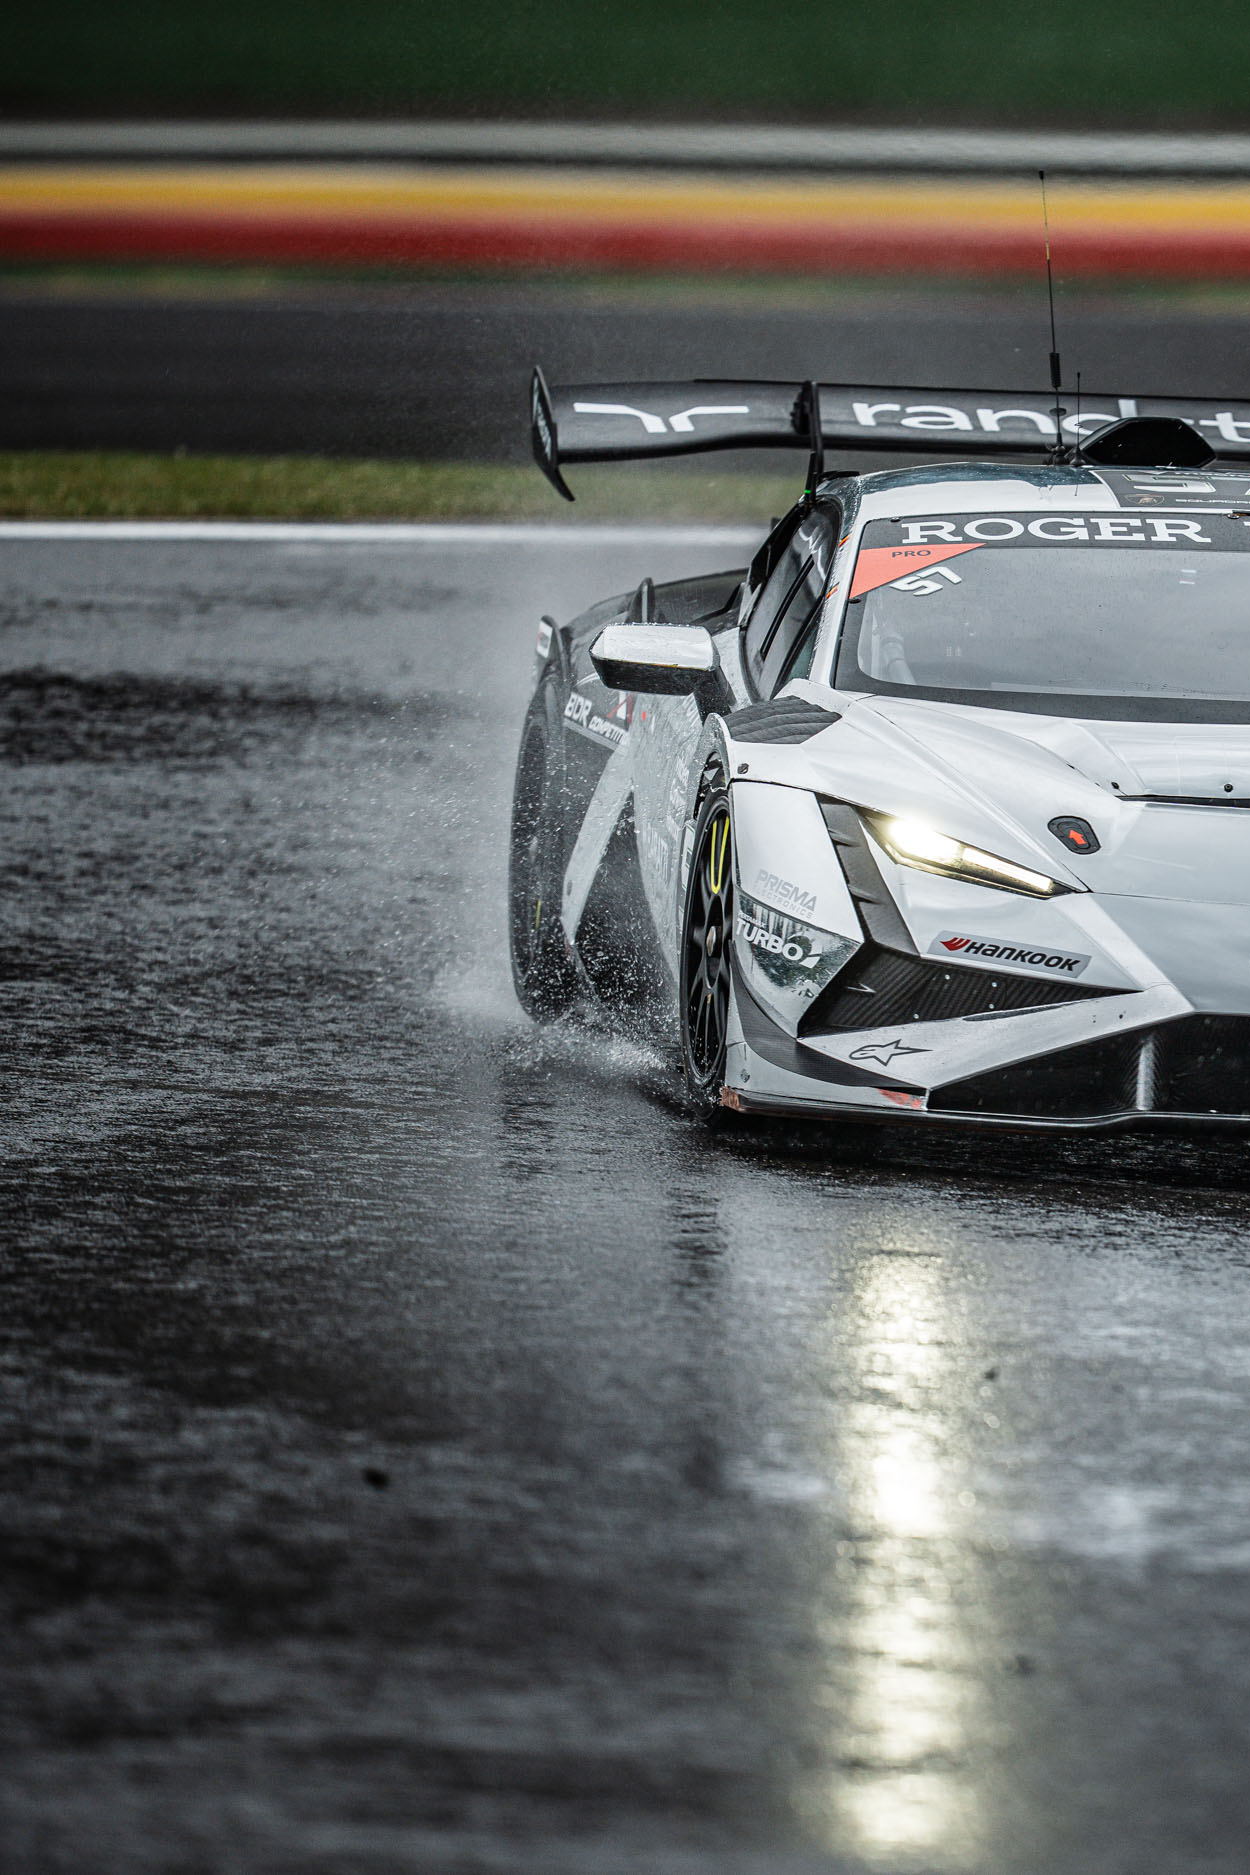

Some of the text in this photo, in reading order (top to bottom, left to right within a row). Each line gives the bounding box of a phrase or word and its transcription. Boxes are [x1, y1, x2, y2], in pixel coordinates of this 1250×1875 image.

[901, 517, 1212, 544] ROGER
[891, 549, 931, 558] PRO
[889, 566, 962, 597] 57
[564, 691, 592, 728] BDR
[755, 868, 817, 912] PRISMA
[736, 918, 803, 961] TURBO
